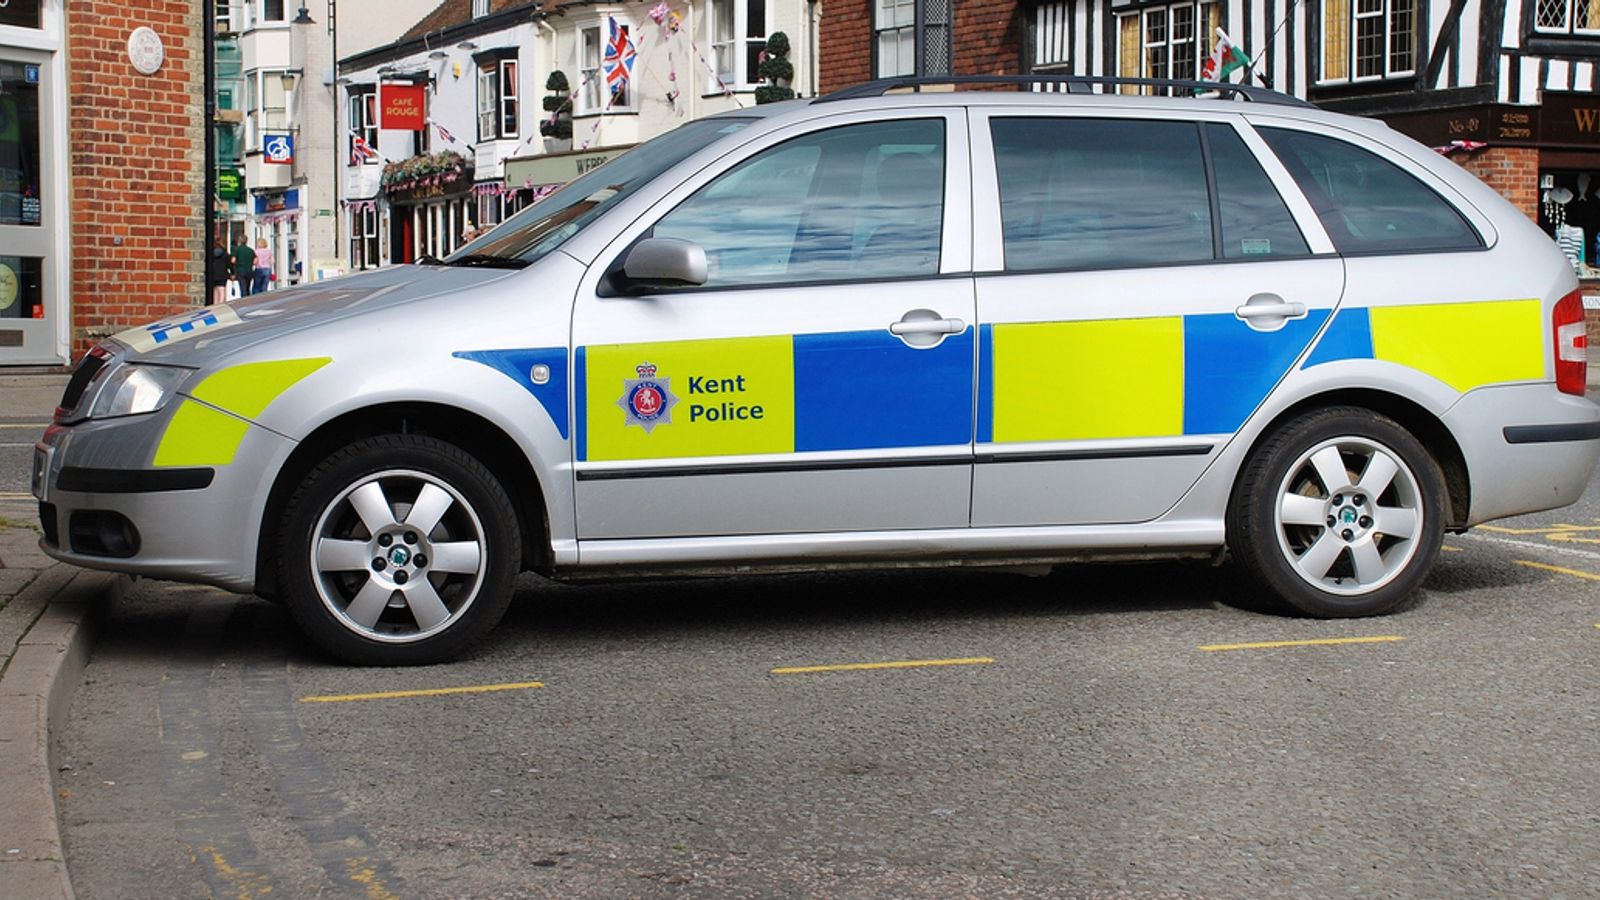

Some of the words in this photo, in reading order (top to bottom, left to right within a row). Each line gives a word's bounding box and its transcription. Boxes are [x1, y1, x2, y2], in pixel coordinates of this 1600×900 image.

[386, 106, 419, 116] ROUGE
[688, 374, 746, 395] Kent
[690, 402, 764, 423] Police
